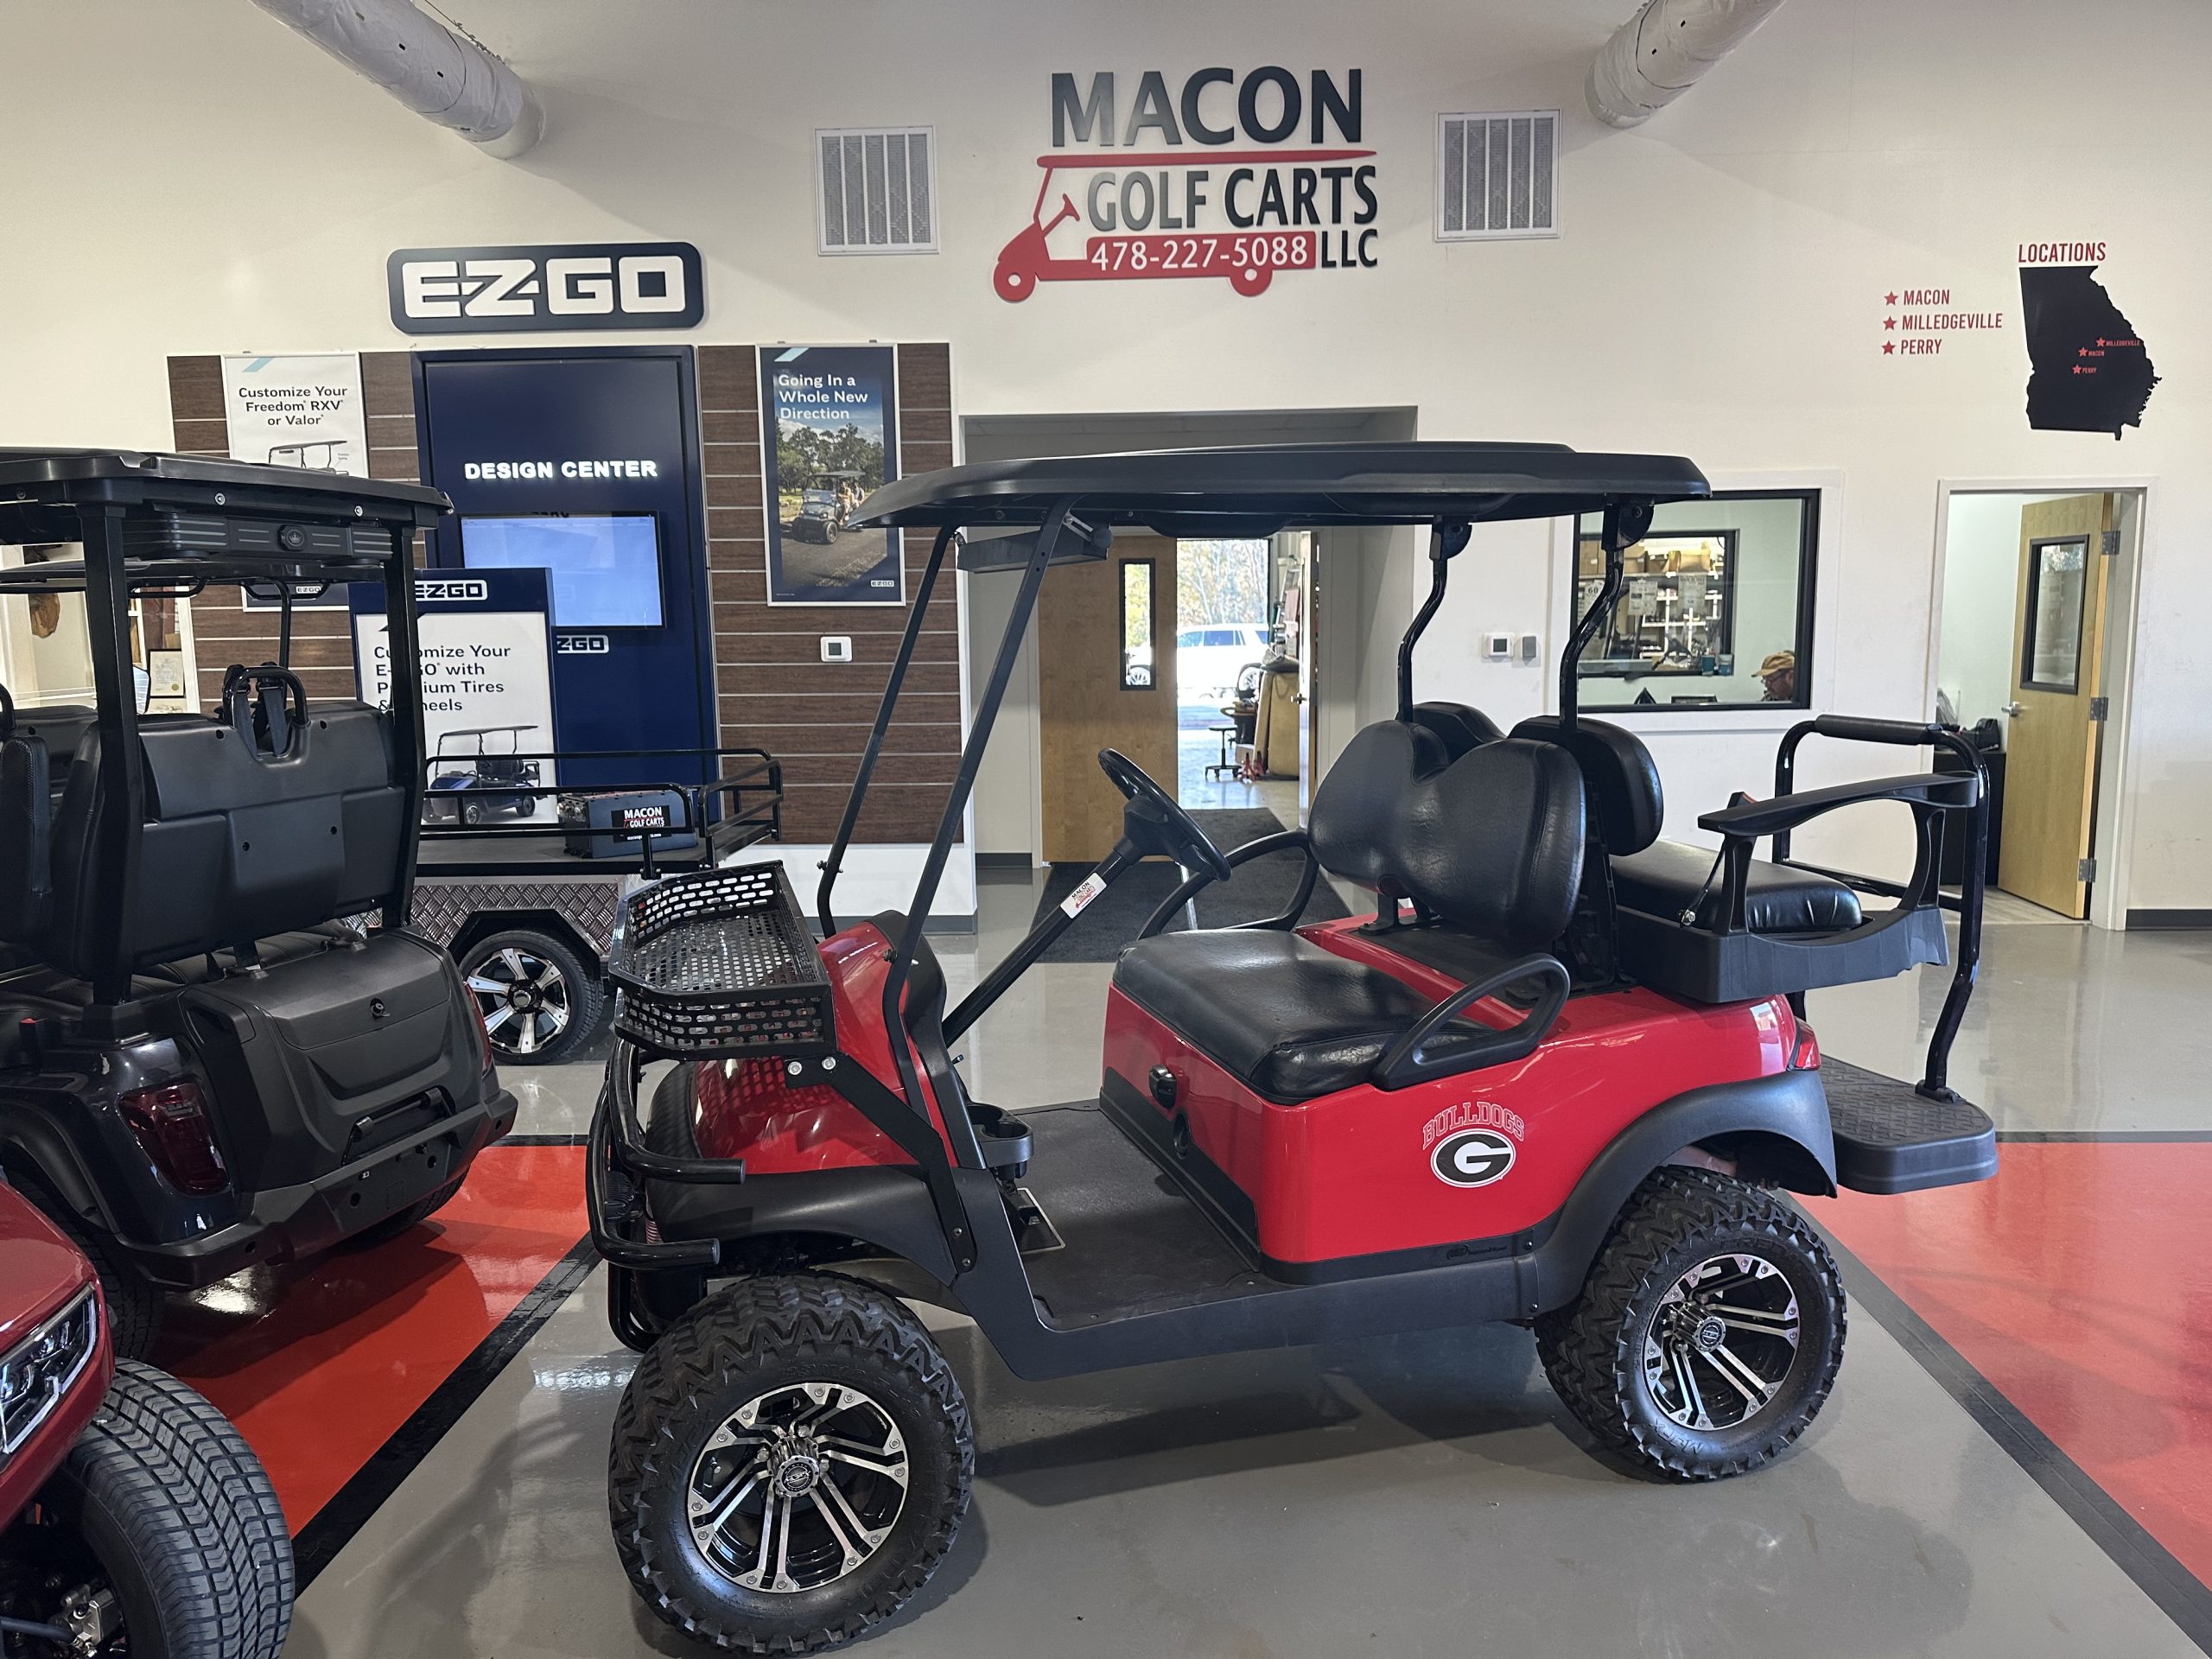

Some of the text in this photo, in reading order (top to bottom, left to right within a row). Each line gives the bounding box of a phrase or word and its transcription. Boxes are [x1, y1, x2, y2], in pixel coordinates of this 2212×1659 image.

[1052, 66, 1362, 147] MACON
[1087, 165, 1378, 232] GOLF CARTS
[1091, 236, 1308, 271] 478-227-5088
[1321, 229, 1378, 269] LLC
[2018, 242, 2107, 263] LOCATIONS
[1904, 289, 1950, 305] MACON
[1902, 313, 2003, 330] MILLEDGEVILLE
[1900, 339, 1942, 355] PERRY
[779, 374, 856, 388] Going In a
[238, 386, 347, 398] Customize Your
[779, 391, 868, 403] Whole New
[780, 407, 850, 419] Direction
[267, 417, 281, 426] or
[464, 460, 658, 480] DESIGN CENTER
[469, 645, 512, 657] Your
[445, 664, 485, 676] with
[461, 680, 505, 693] Tires
[624, 807, 663, 819] MACON
[630, 819, 645, 828] GOLF
[645, 817, 664, 826] CARTS
[1071, 881, 1090, 899] MACON
[1422, 1101, 1525, 1150] BULLDOGS
[1434, 1132, 1513, 1183] G
